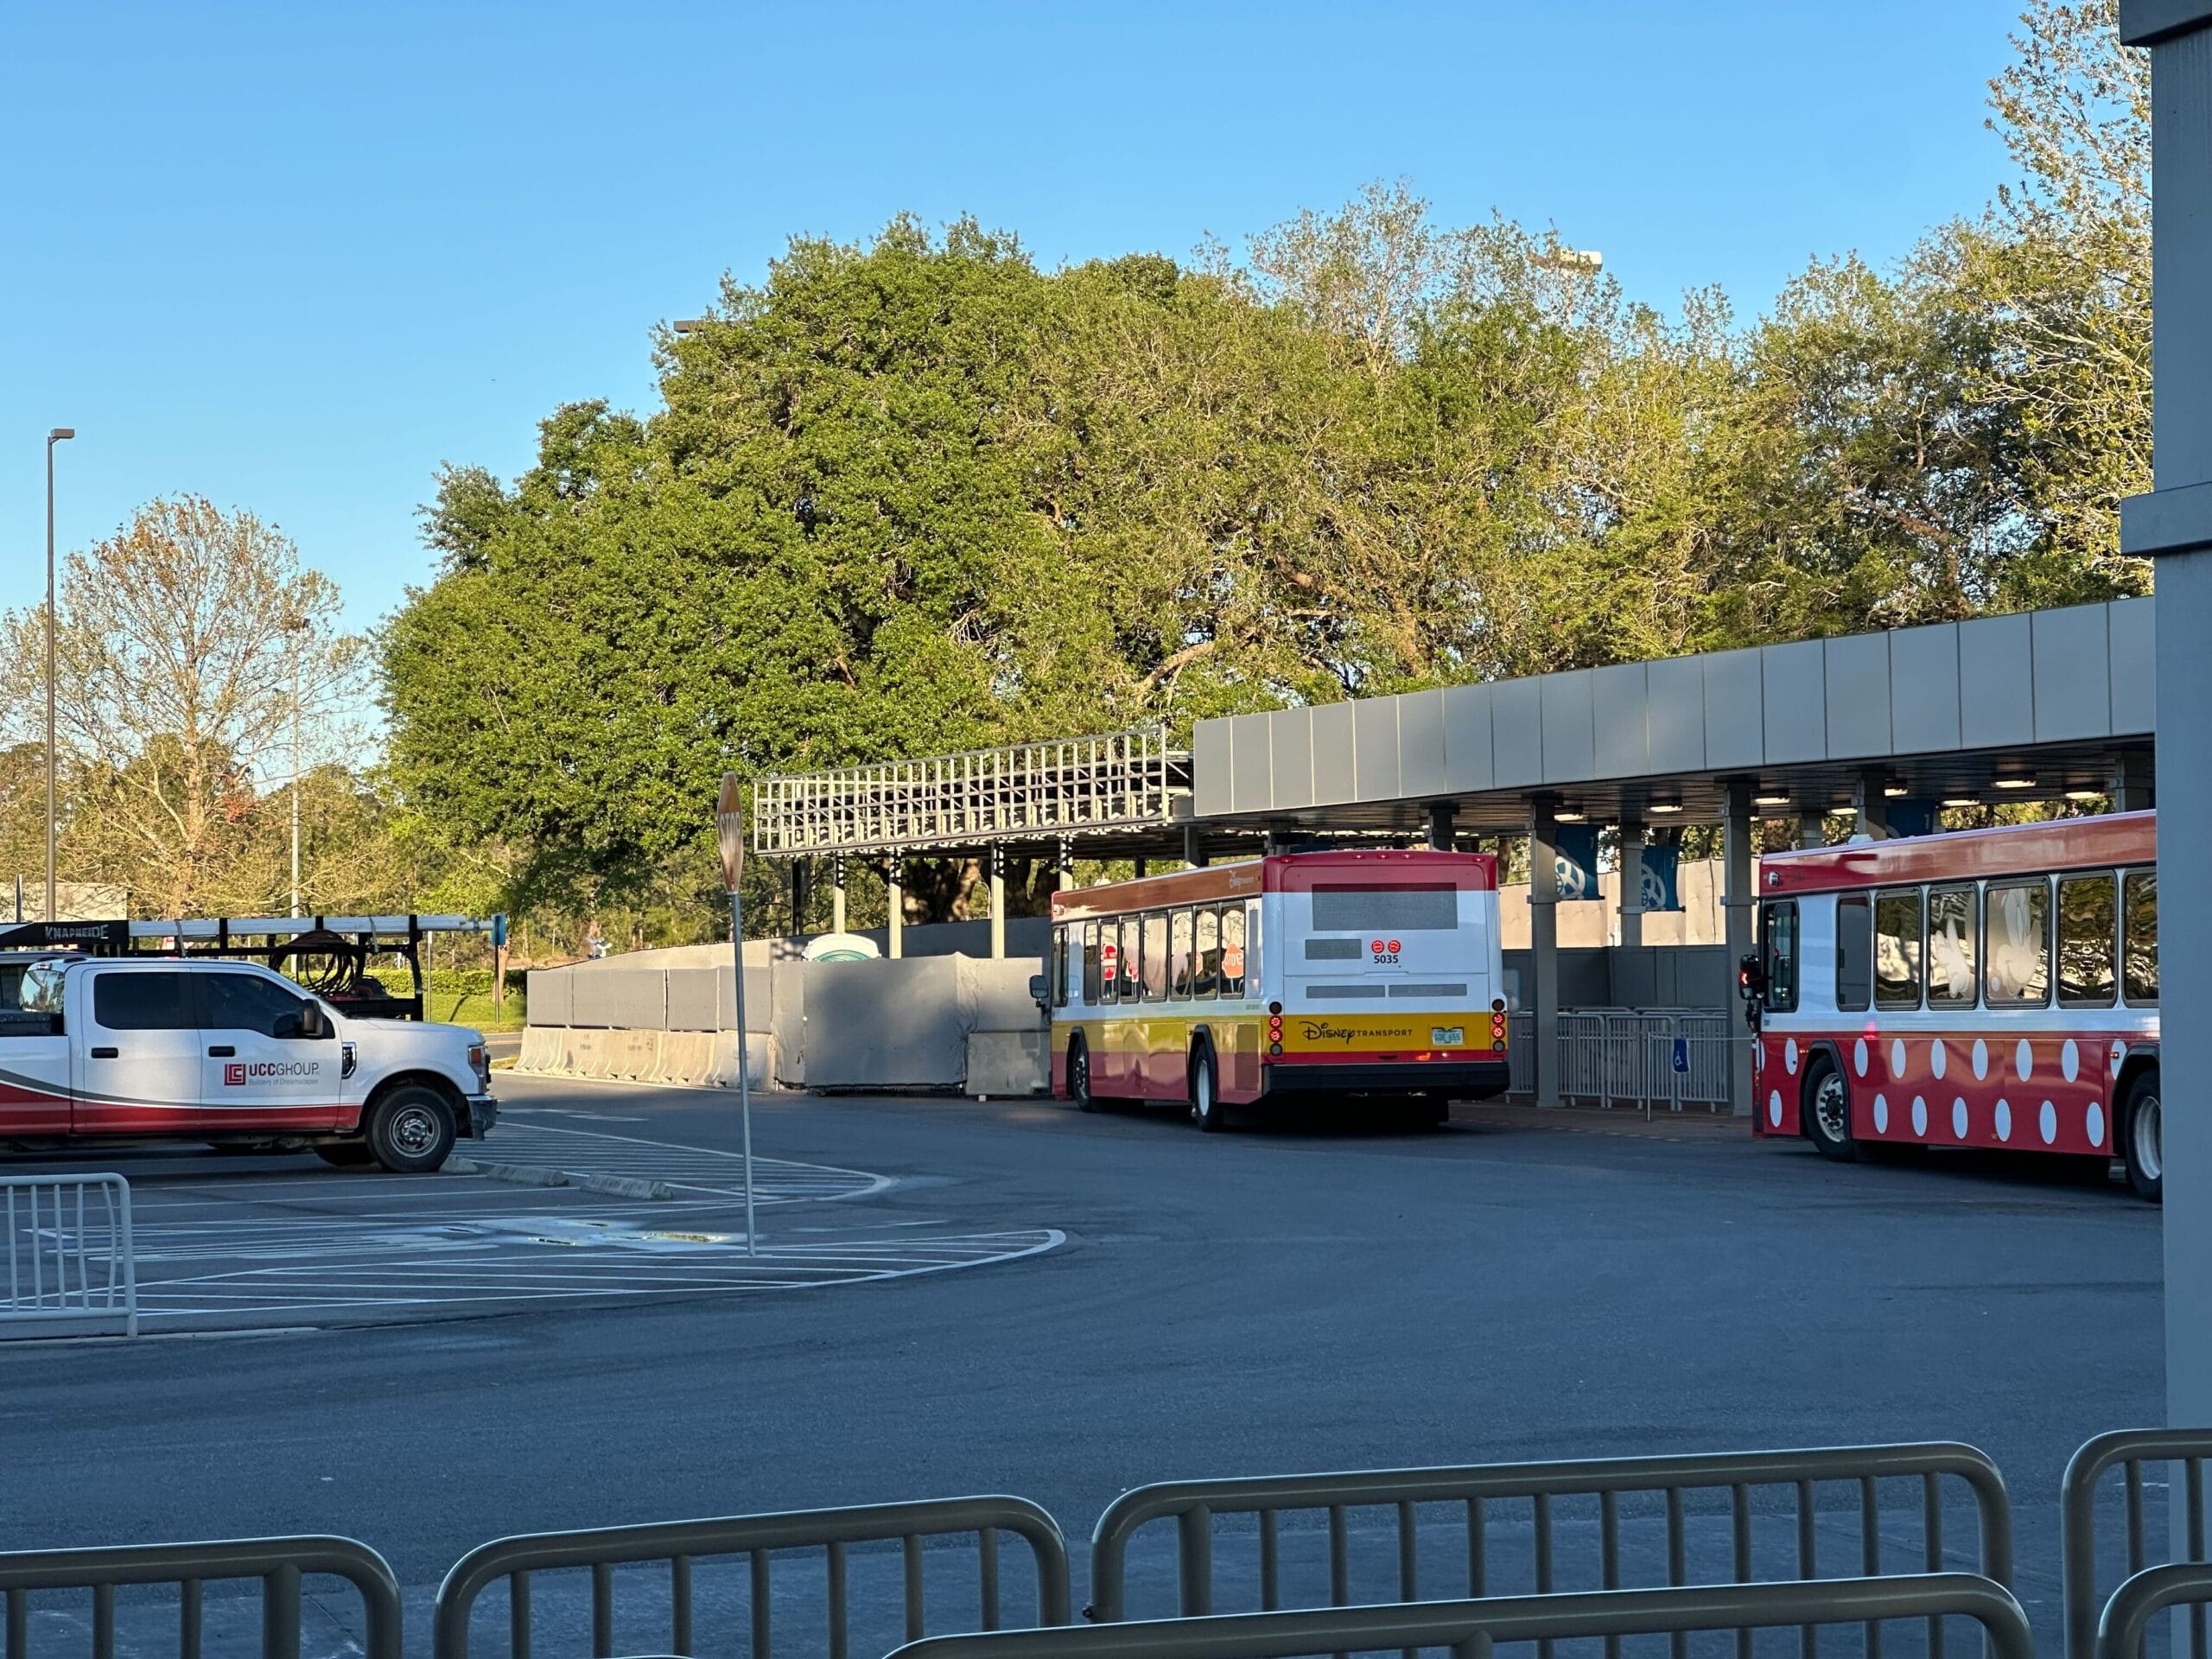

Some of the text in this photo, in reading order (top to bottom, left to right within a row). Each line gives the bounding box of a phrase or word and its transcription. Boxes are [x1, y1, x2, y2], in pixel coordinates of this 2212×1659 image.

[719, 811, 741, 856] STOP
[1374, 954, 1399, 964] 5035
[1299, 1020, 1413, 1045] Disney TRANSPORT
